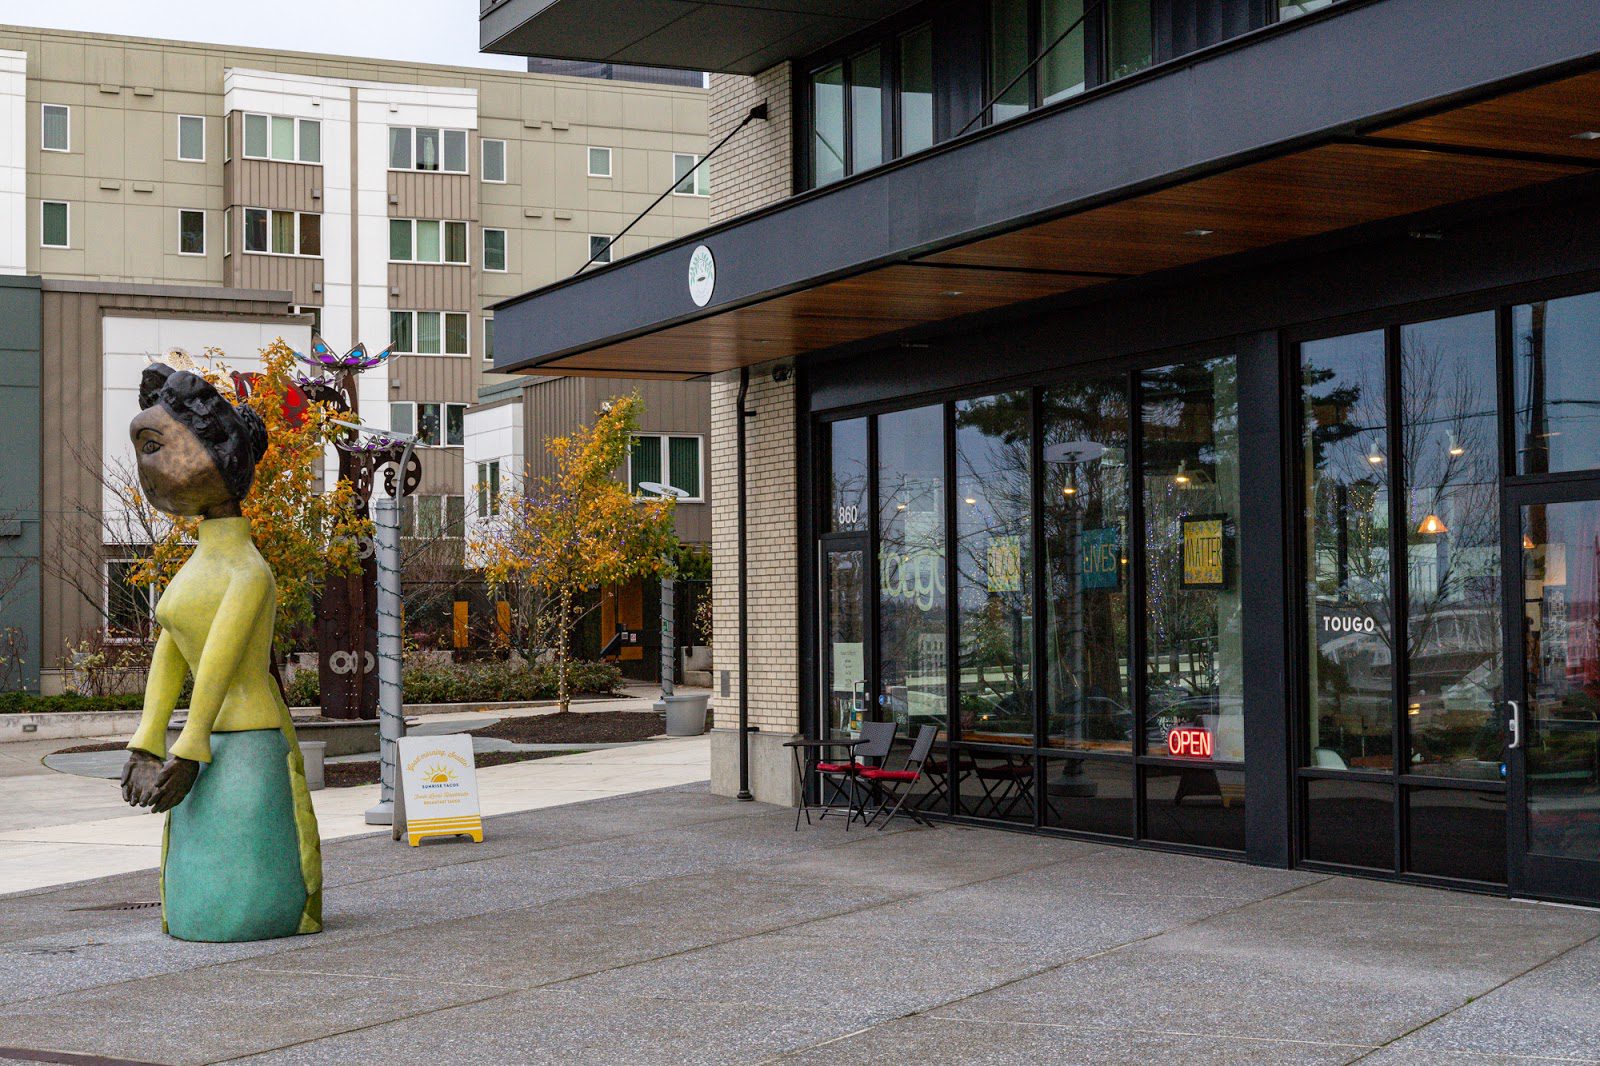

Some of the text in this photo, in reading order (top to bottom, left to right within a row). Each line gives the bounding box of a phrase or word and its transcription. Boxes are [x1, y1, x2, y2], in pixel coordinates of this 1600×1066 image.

[839, 506, 857, 524] 860
[987, 550, 1020, 577] BLACK
[1083, 543, 1116, 573] LIVES
[1184, 537, 1221, 566] MATTER
[1323, 616, 1374, 632] TOUGO
[1169, 730, 1211, 756] OPEN
